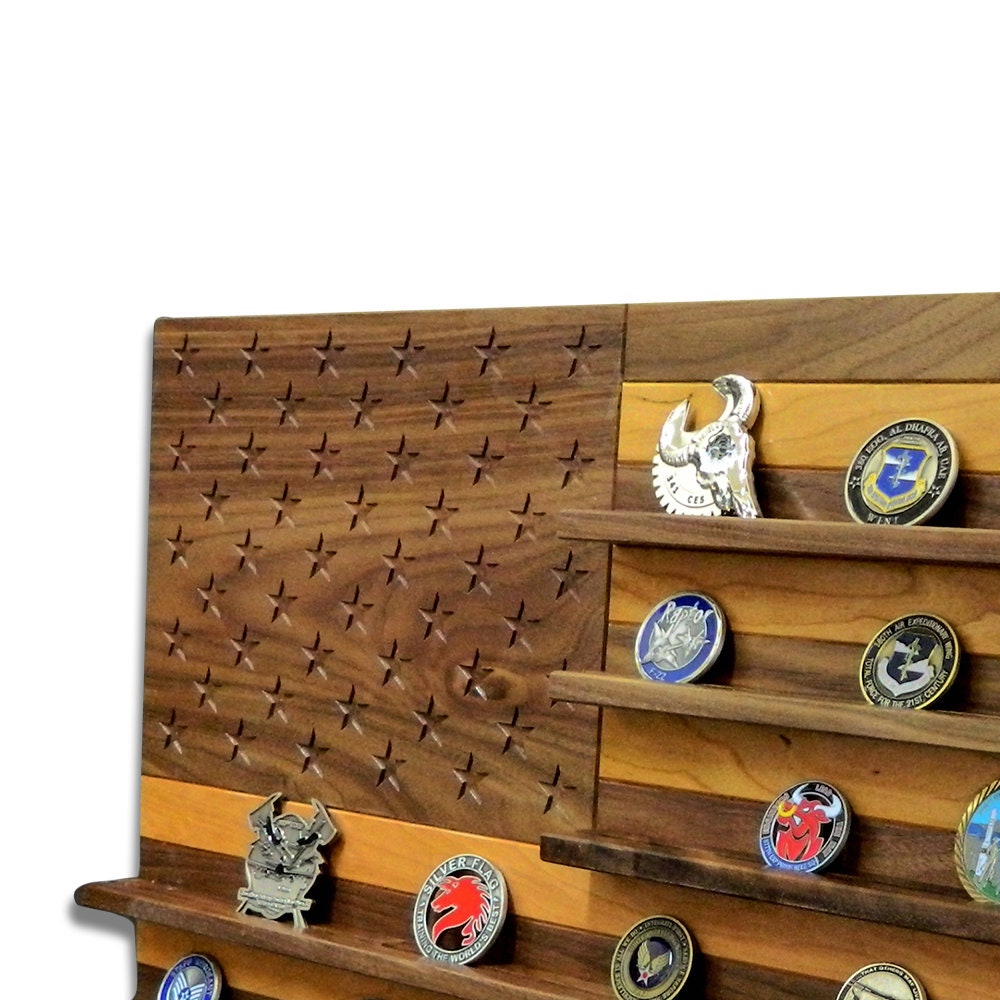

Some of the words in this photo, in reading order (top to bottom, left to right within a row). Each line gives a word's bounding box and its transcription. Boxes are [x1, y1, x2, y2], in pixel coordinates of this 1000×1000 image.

[890, 425, 903, 436] AL
[905, 423, 938, 441] DHAFRA
[938, 457, 949, 480] UAE
[667, 475, 679, 494] 341
[687, 495, 705, 505] CES
[894, 621, 906, 632] AIR
[649, 669, 667, 680] F-22
[865, 679, 880, 699] FORCE
[924, 669, 948, 698] CENTURY
[424, 857, 466, 894] SILVER
[471, 858, 499, 890] FLAG
[416, 908, 432, 953] TRAINING
[432, 950, 448, 961] THE
[488, 905, 500, 932] BEST
[878, 966, 903, 976] OTHERS
[904, 974, 914, 987] MAY
